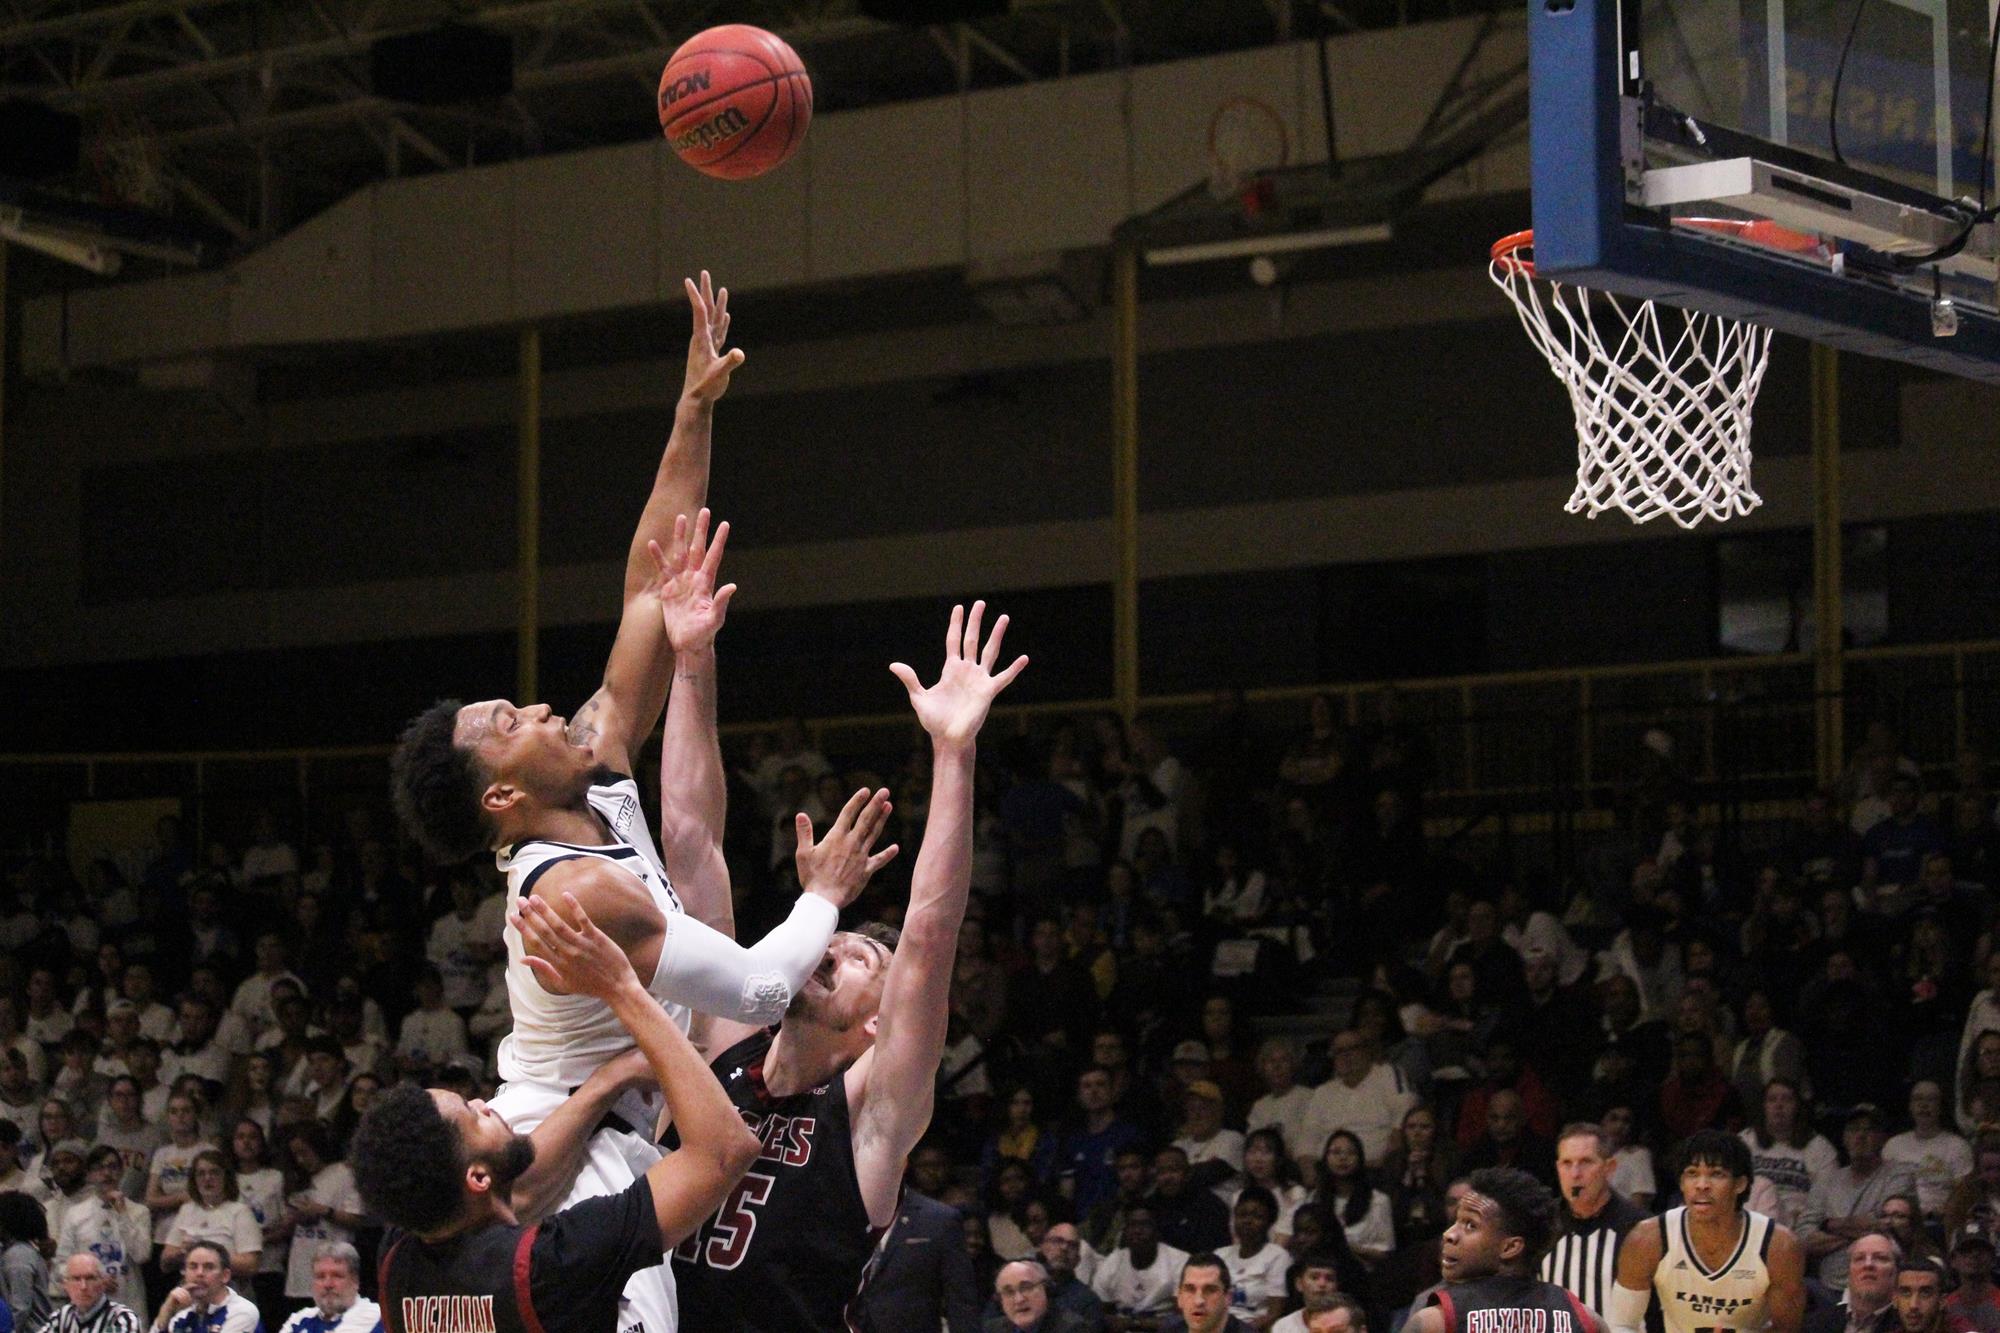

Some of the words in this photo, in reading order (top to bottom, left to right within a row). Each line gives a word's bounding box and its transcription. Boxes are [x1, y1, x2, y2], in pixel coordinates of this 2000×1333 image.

[1676, 1291, 1752, 1307] KANSAS
[1692, 1303, 1736, 1315] CITY
[402, 1295, 496, 1333] BUCHANAN
[1467, 1308, 1547, 1333] GILYARD
